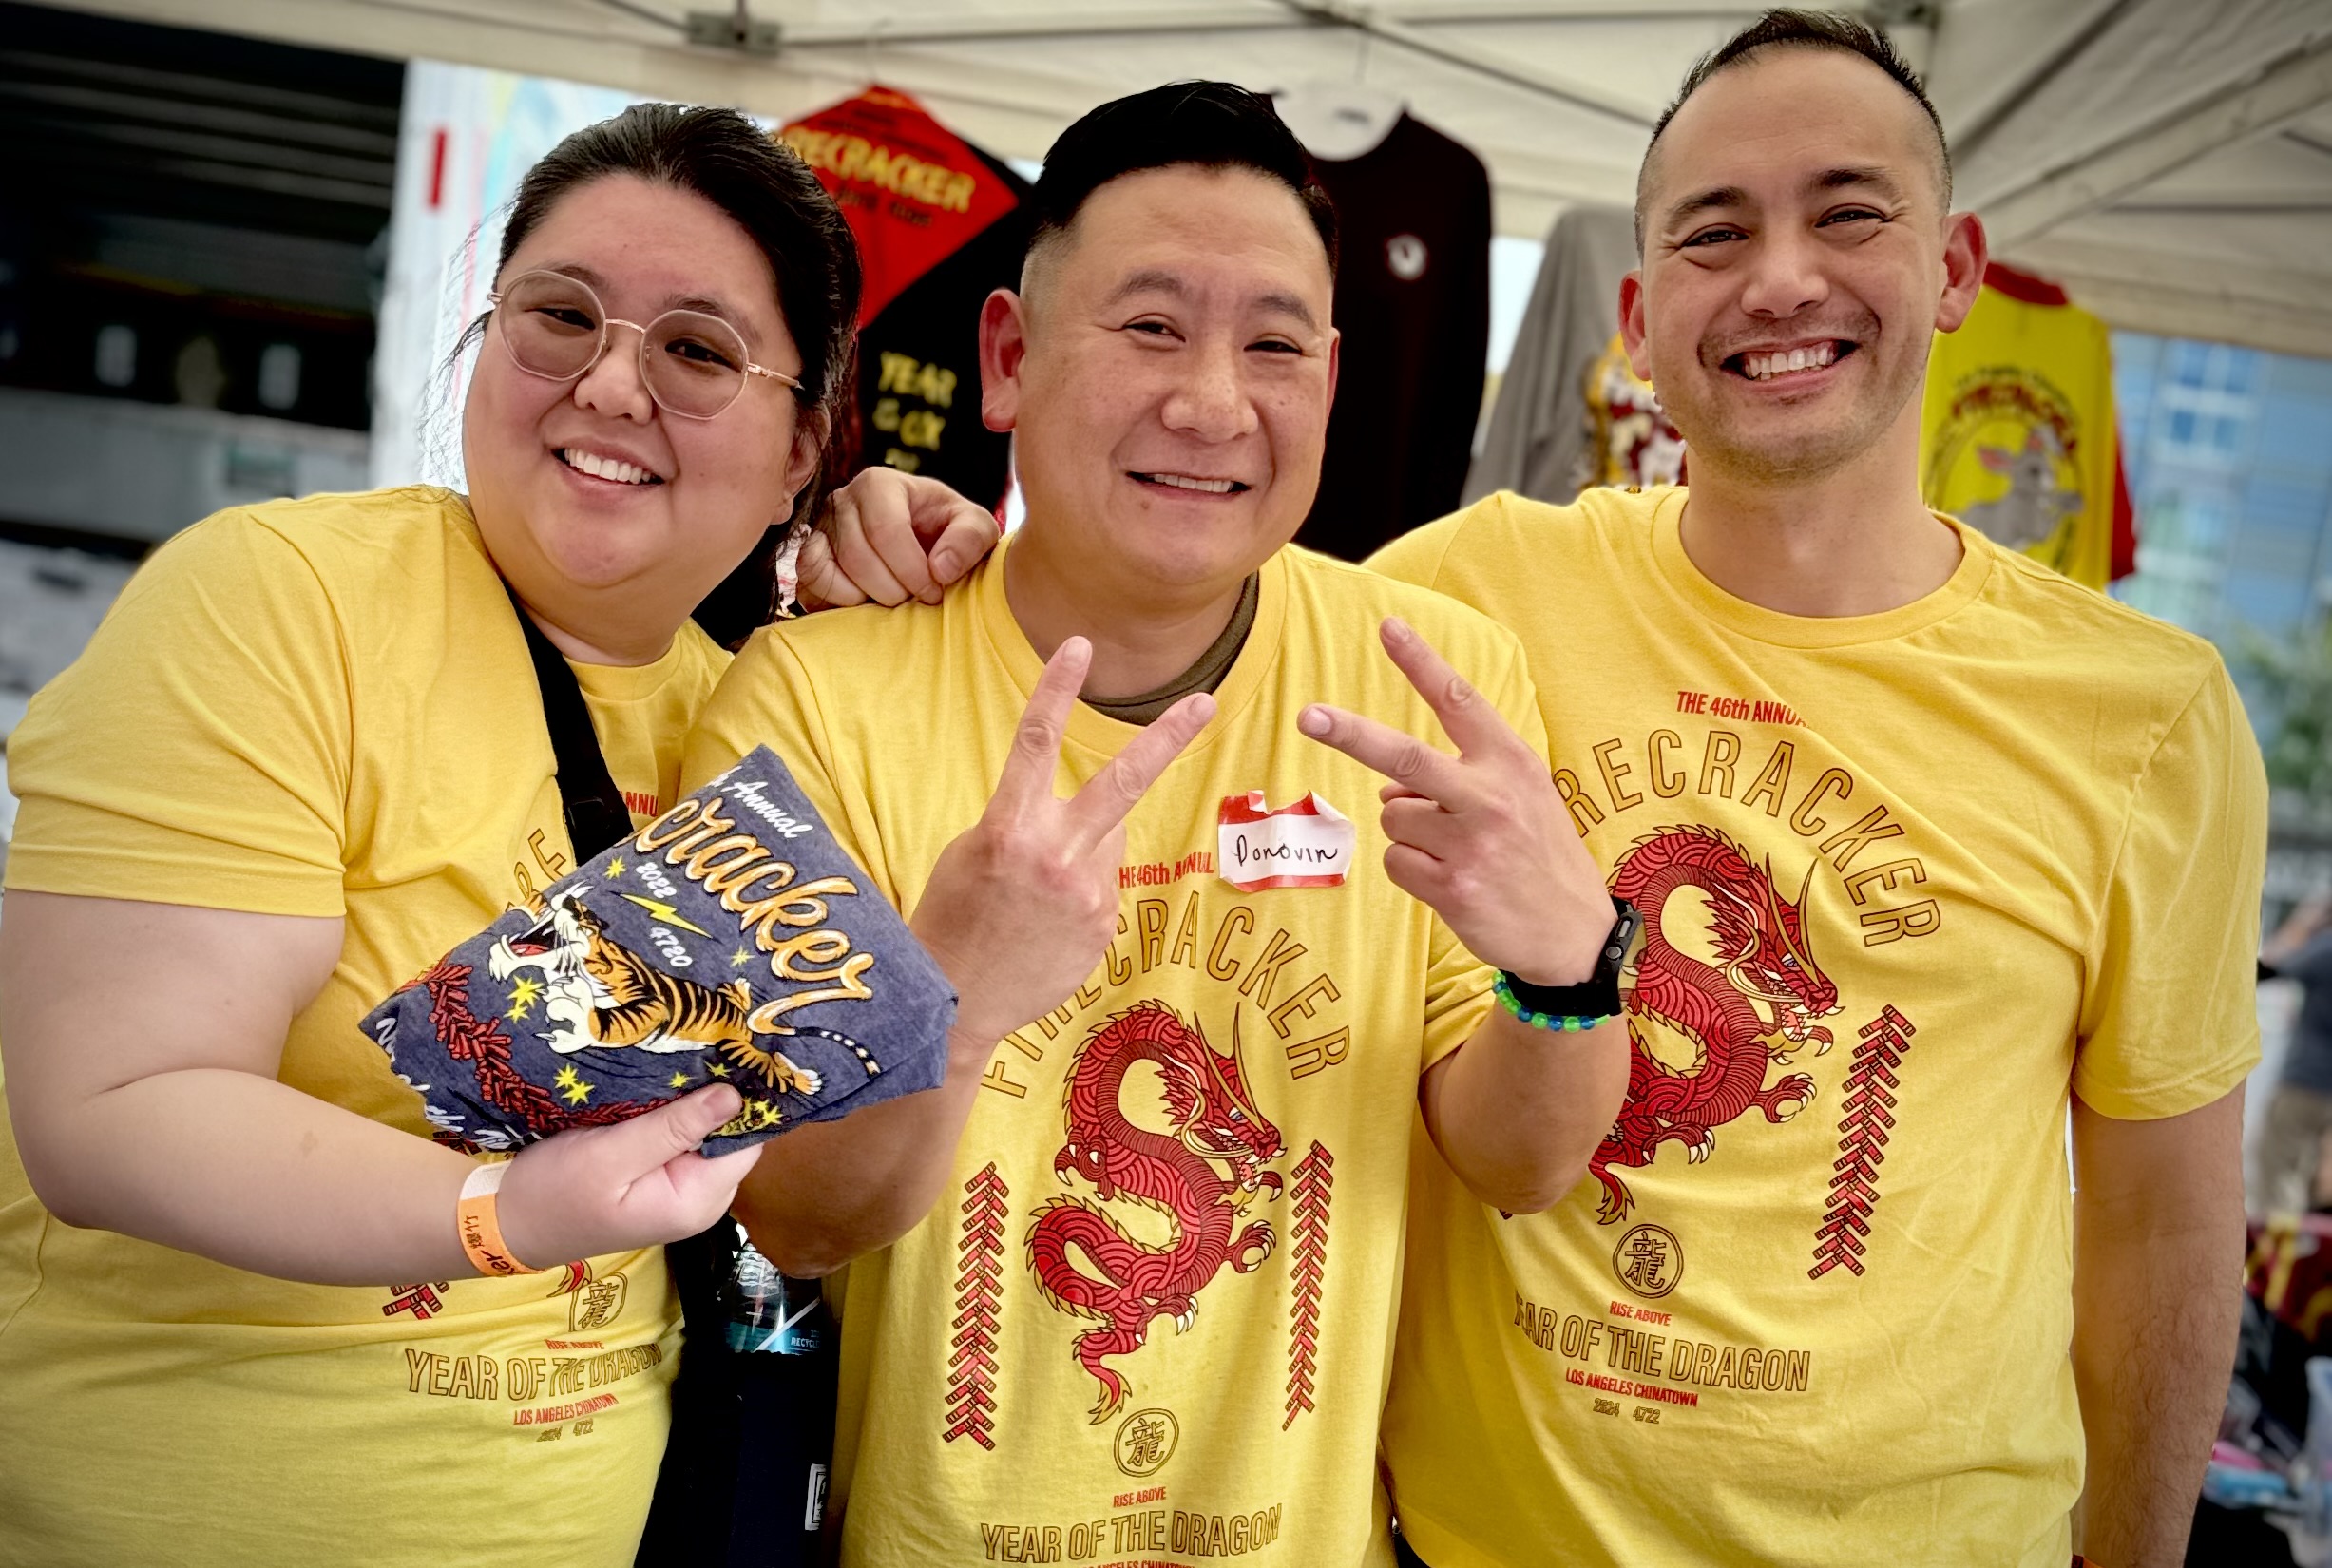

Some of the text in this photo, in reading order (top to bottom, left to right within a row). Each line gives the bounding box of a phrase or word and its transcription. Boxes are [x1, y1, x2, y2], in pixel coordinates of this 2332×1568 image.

[878, 351, 957, 409] YEAR
[1676, 691, 1709, 715] THE
[1709, 697, 1750, 721] 46th
[720, 780, 814, 839] Annual
[635, 862, 678, 899] 2022
[649, 927, 694, 967] 4720
[980, 889, 1350, 1100] FICRACKER
[1624, 1231, 1667, 1289] 龍
[1609, 1301, 1672, 1327] RISE ABOVE
[404, 1343, 663, 1402] YEAR OF THE DRAGON
[1560, 1315, 1604, 1361] OF
[1606, 1326, 1664, 1377] THE
[1669, 1339, 1811, 1392] DRAGON
[1565, 1367, 1699, 1408] LOS ANGELES CHINATOWN
[513, 1392, 620, 1425] LOS ANGELES CHINATOWN
[572, 1418, 594, 1437] 4722
[1633, 1406, 1661, 1425] 4722
[1125, 1418, 1167, 1467] 龍
[1112, 1486, 1167, 1508] RISE ABOVE
[980, 1503, 1282, 1563] YEAR OF THE DRAGON
